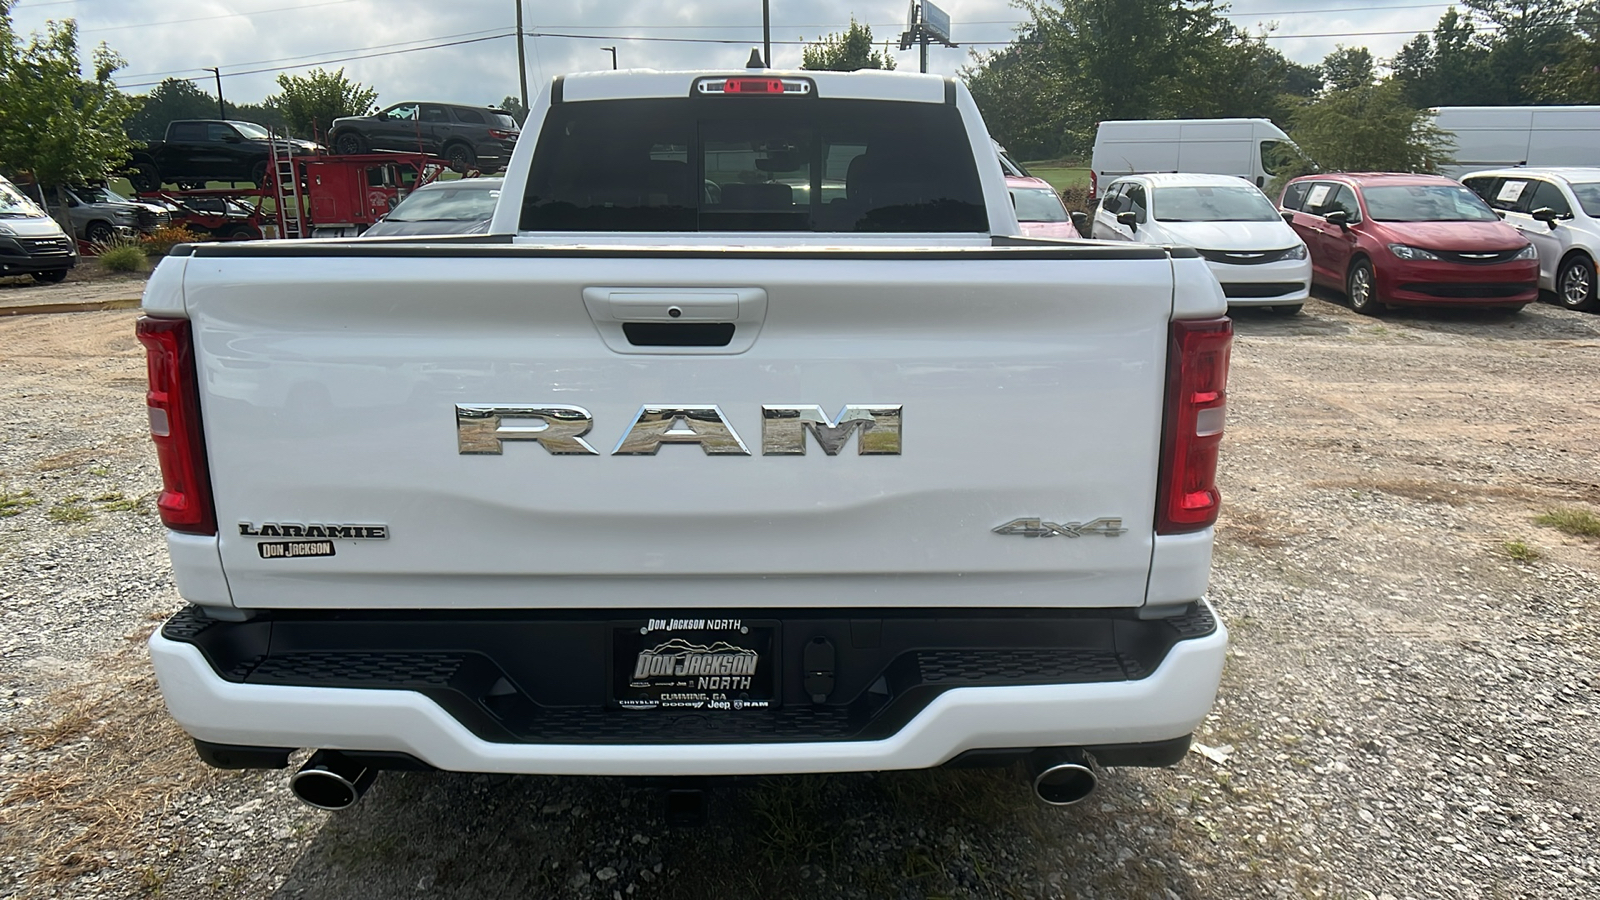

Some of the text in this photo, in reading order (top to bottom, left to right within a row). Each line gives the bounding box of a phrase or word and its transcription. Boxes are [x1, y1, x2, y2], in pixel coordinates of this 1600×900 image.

[455, 403, 903, 456] RAM
[238, 522, 390, 540] LARAMIE
[991, 517, 1129, 538] 4x4
[262, 542, 331, 558] DON JACKSON
[648, 618, 741, 631] DON JACKSON NORTH
[634, 653, 758, 679] DON JACKSON
[697, 677, 752, 690] NORTH
[712, 693, 727, 701] GA
[707, 700, 731, 711] Jeep
